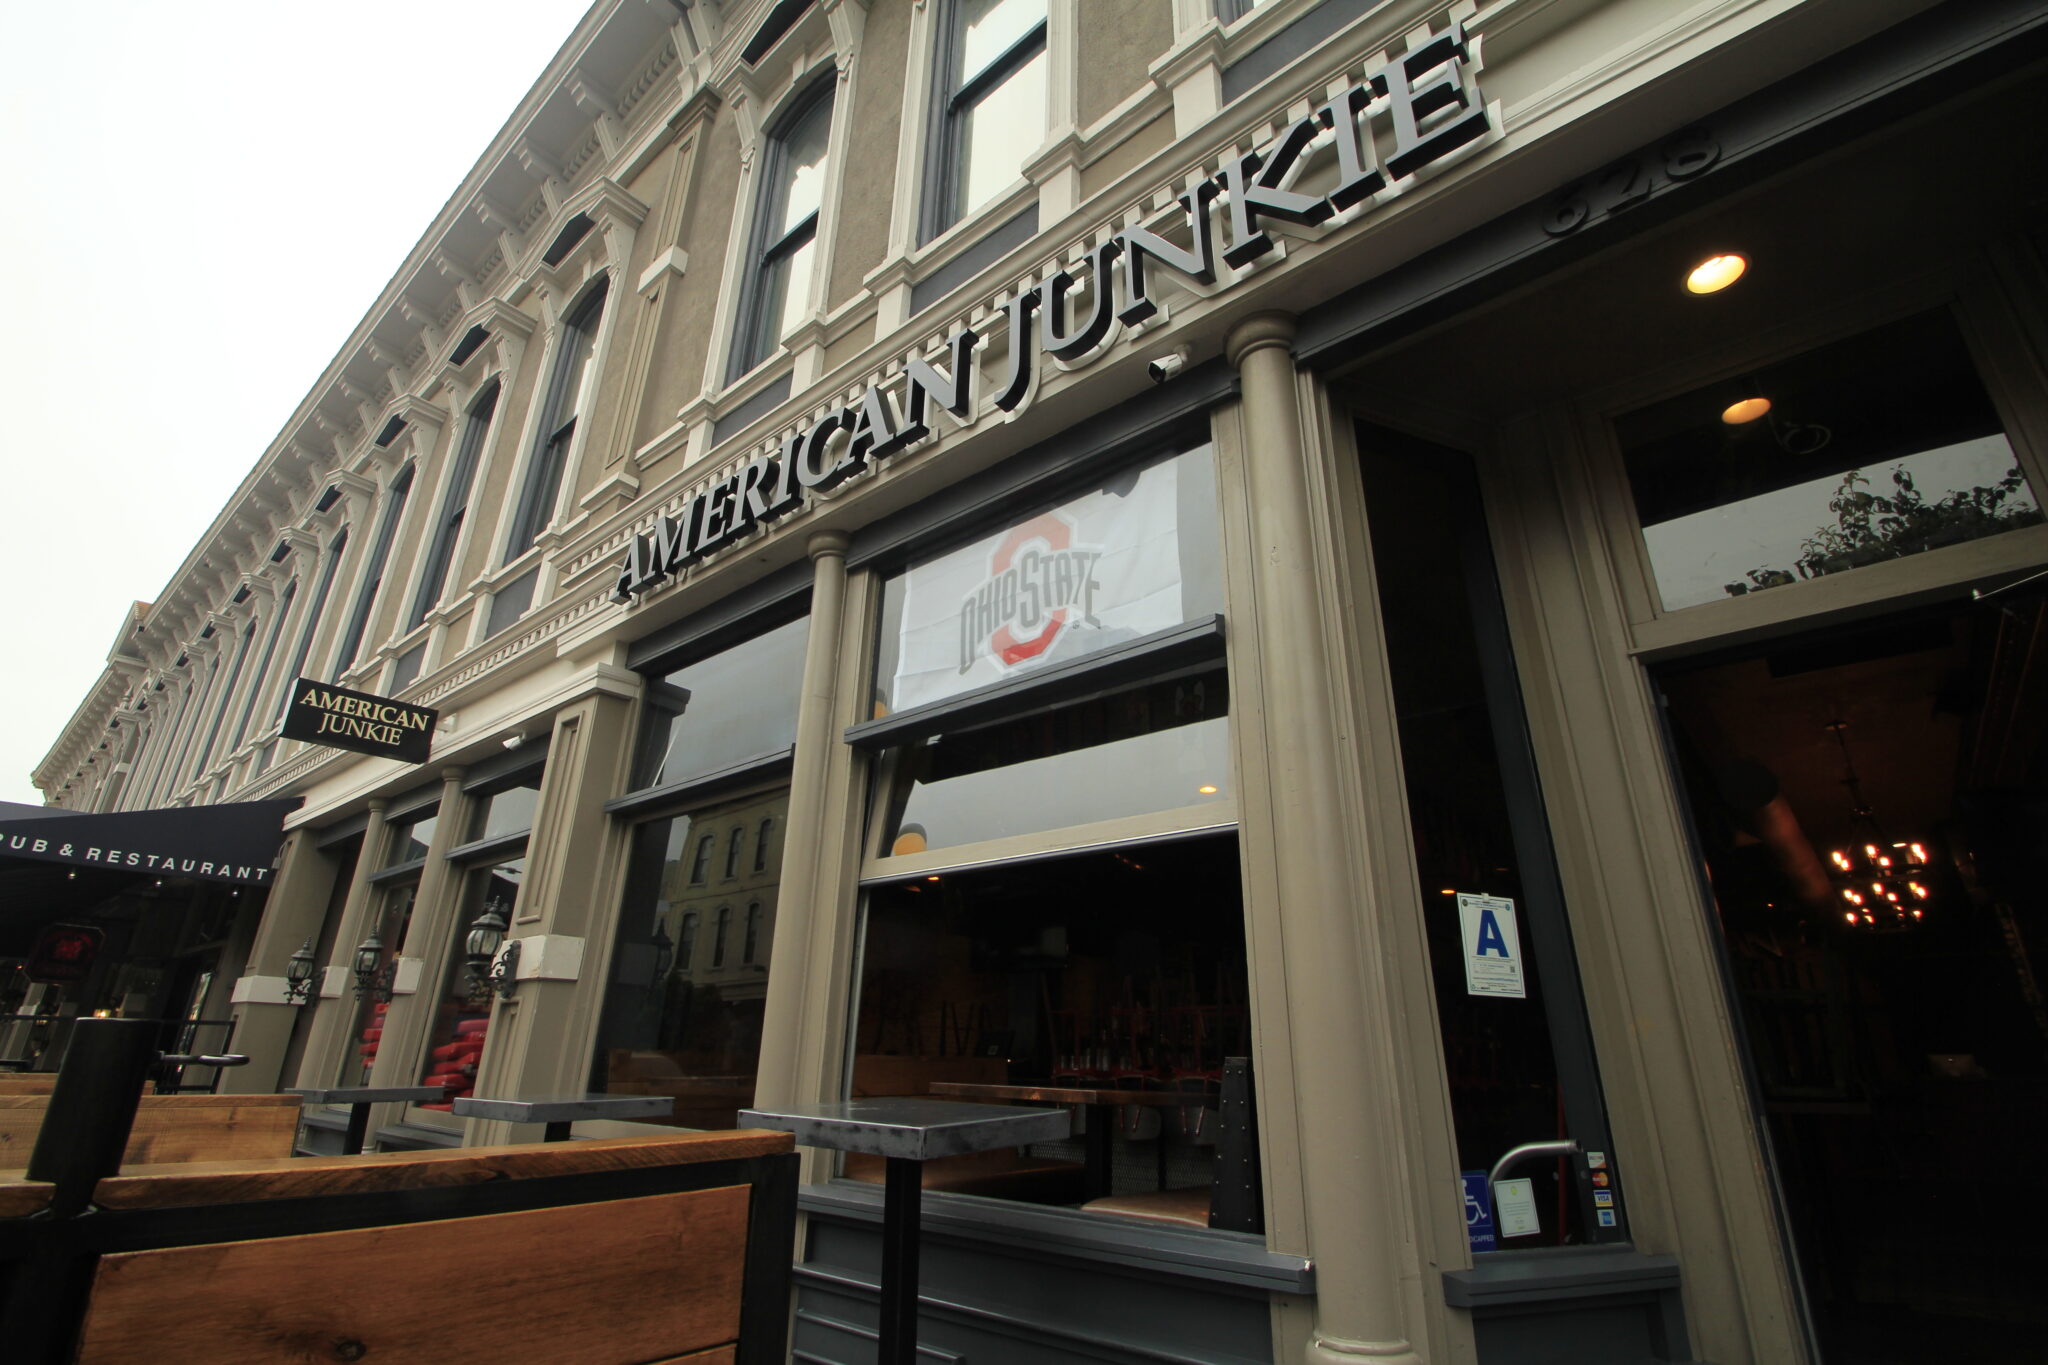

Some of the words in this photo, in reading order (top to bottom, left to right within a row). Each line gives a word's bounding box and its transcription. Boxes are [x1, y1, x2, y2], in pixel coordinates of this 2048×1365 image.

[612, 328, 980, 604] AMERICAN
[994, 20, 1492, 414] JUNKIE
[959, 568, 1018, 676] OHIO
[1020, 550, 1102, 630] STATE
[300, 688, 430, 732] AMERICAN
[317, 712, 403, 746] JUNKIE
[59, 843, 74, 857] &
[86, 847, 268, 880] RESTAURANT
[1476, 909, 1510, 958] A
